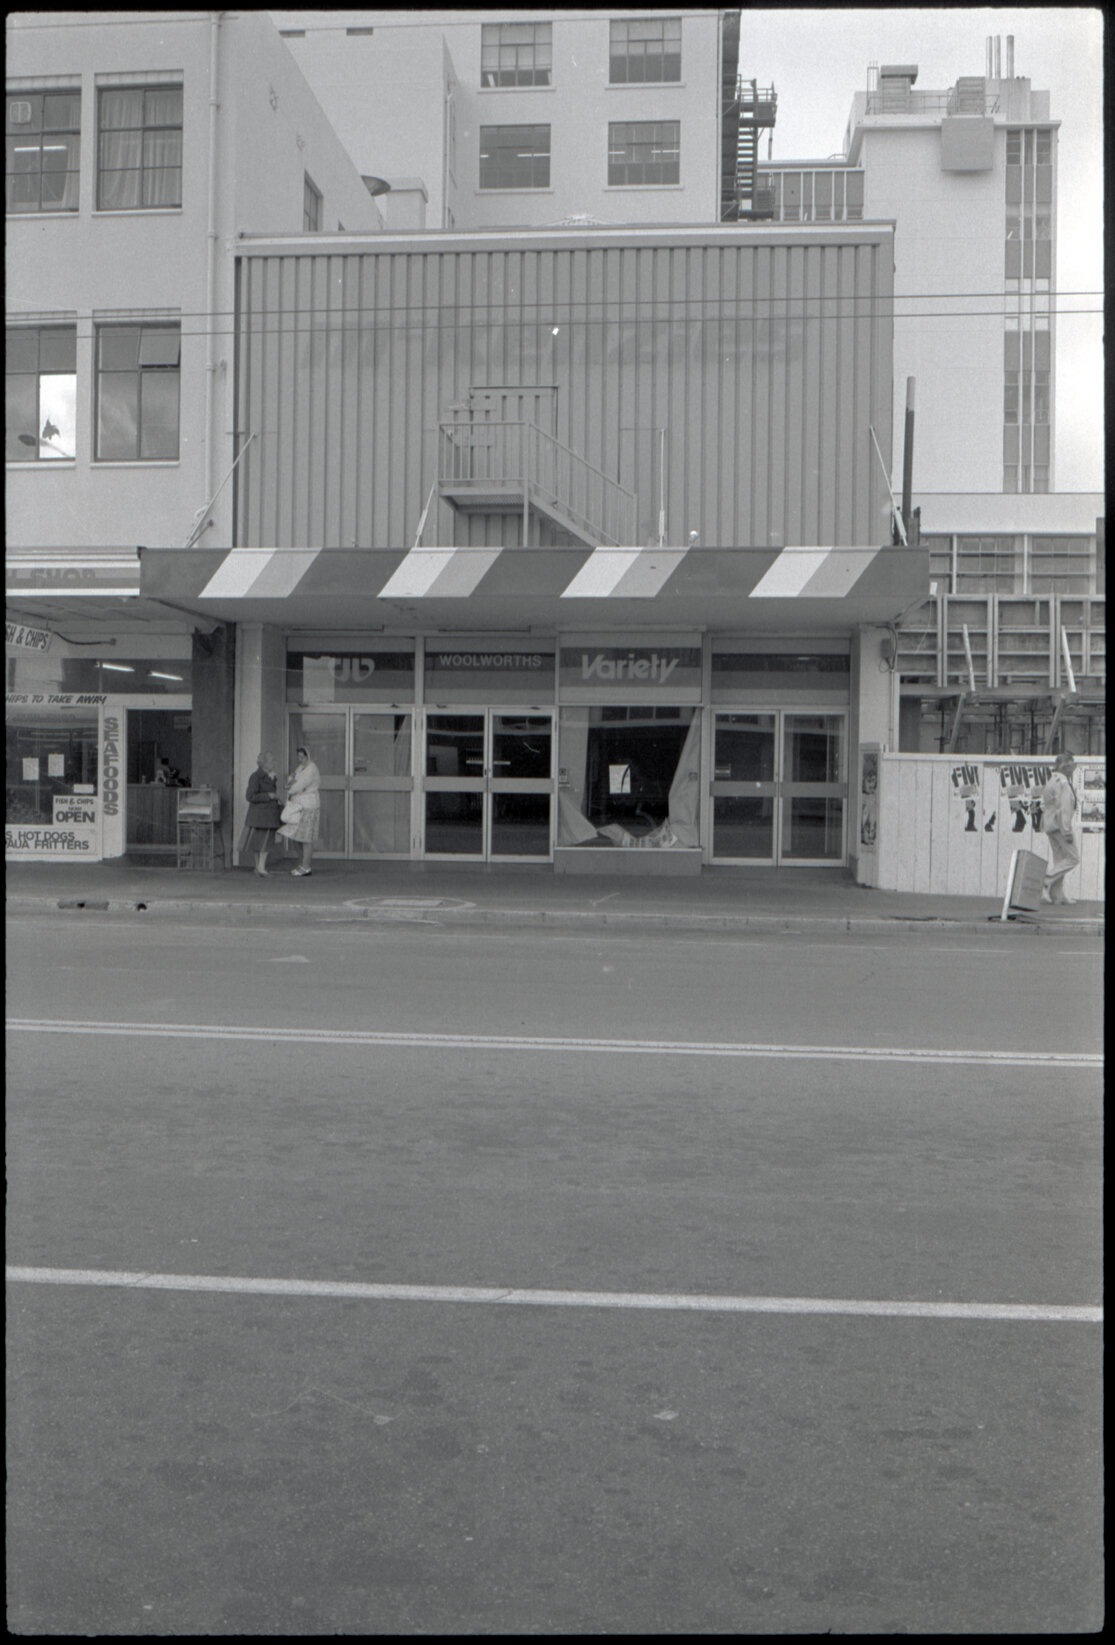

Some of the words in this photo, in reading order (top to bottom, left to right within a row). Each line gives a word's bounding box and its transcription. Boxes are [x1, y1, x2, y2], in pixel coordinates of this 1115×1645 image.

[16, 627, 25, 644] &
[25, 629, 49, 649] CHIPS
[439, 654, 543, 668] WOOLWORTHS
[581, 653, 680, 684] Variety
[32, 694, 44, 704] TO
[48, 695, 74, 705] TAKE
[76, 695, 108, 705] AWAY
[103, 717, 120, 816] SEAFOODS
[55, 810, 96, 824] OPEN
[18, 831, 41, 841] HOT
[43, 831, 76, 842] DOGS
[34, 840, 90, 850] FRITTERS
